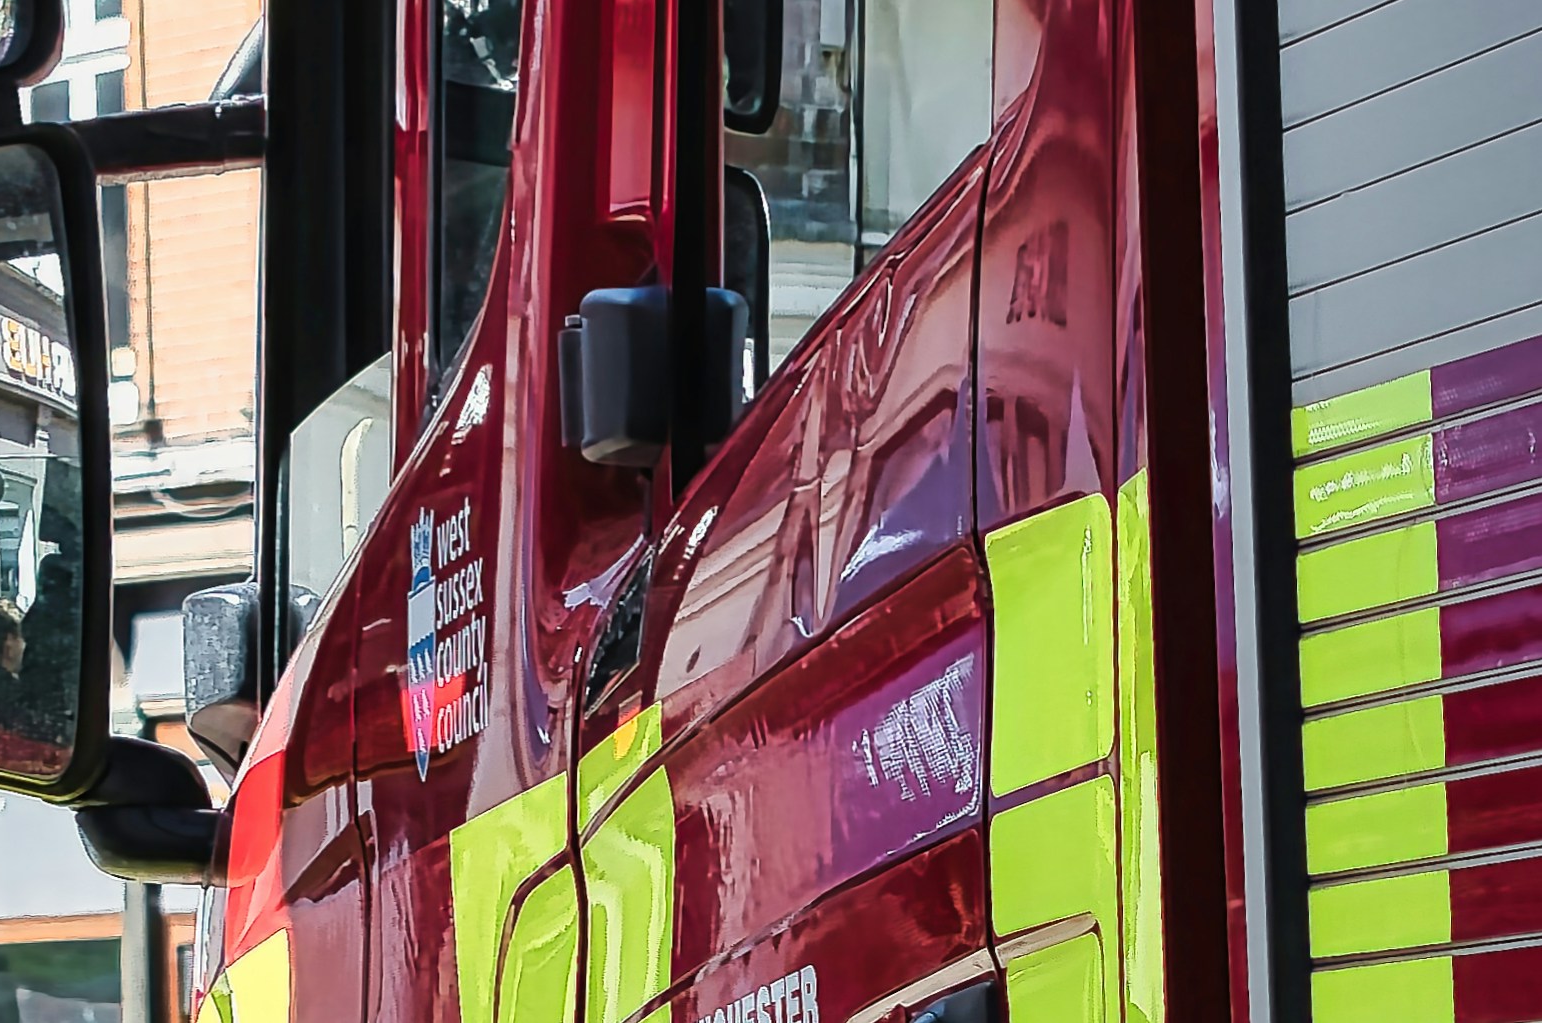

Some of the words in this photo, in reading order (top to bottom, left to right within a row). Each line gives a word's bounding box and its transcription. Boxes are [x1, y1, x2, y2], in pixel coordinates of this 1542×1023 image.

[436, 497, 471, 569] west
[436, 557, 483, 630] sussex
[436, 611, 487, 688] county
[436, 662, 490, 754] council
